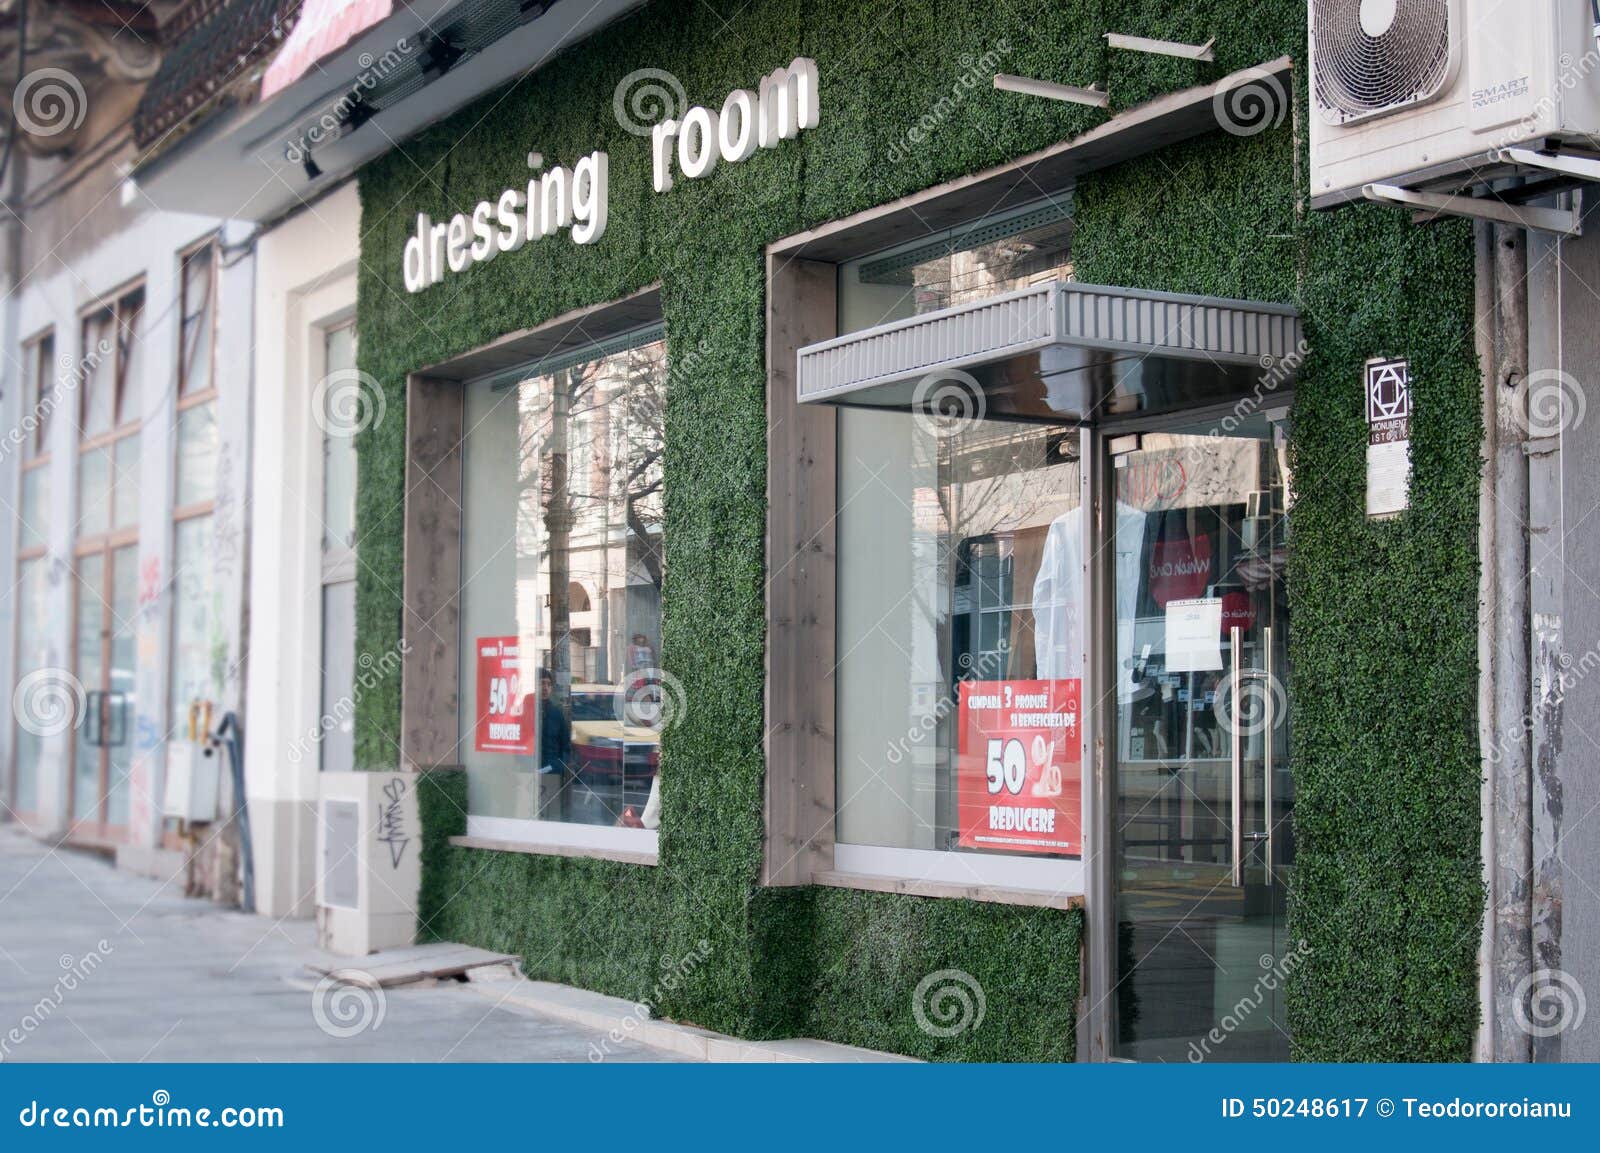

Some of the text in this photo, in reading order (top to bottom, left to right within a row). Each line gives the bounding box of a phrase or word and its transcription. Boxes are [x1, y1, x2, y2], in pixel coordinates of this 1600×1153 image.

[1472, 76, 1528, 101] SMART
[403, 57, 820, 293] dressing room
[486, 677, 508, 715] 50
[1004, 685, 1012, 709] 3
[986, 737, 1027, 796] 50
[989, 805, 1056, 833] REDUCERE
